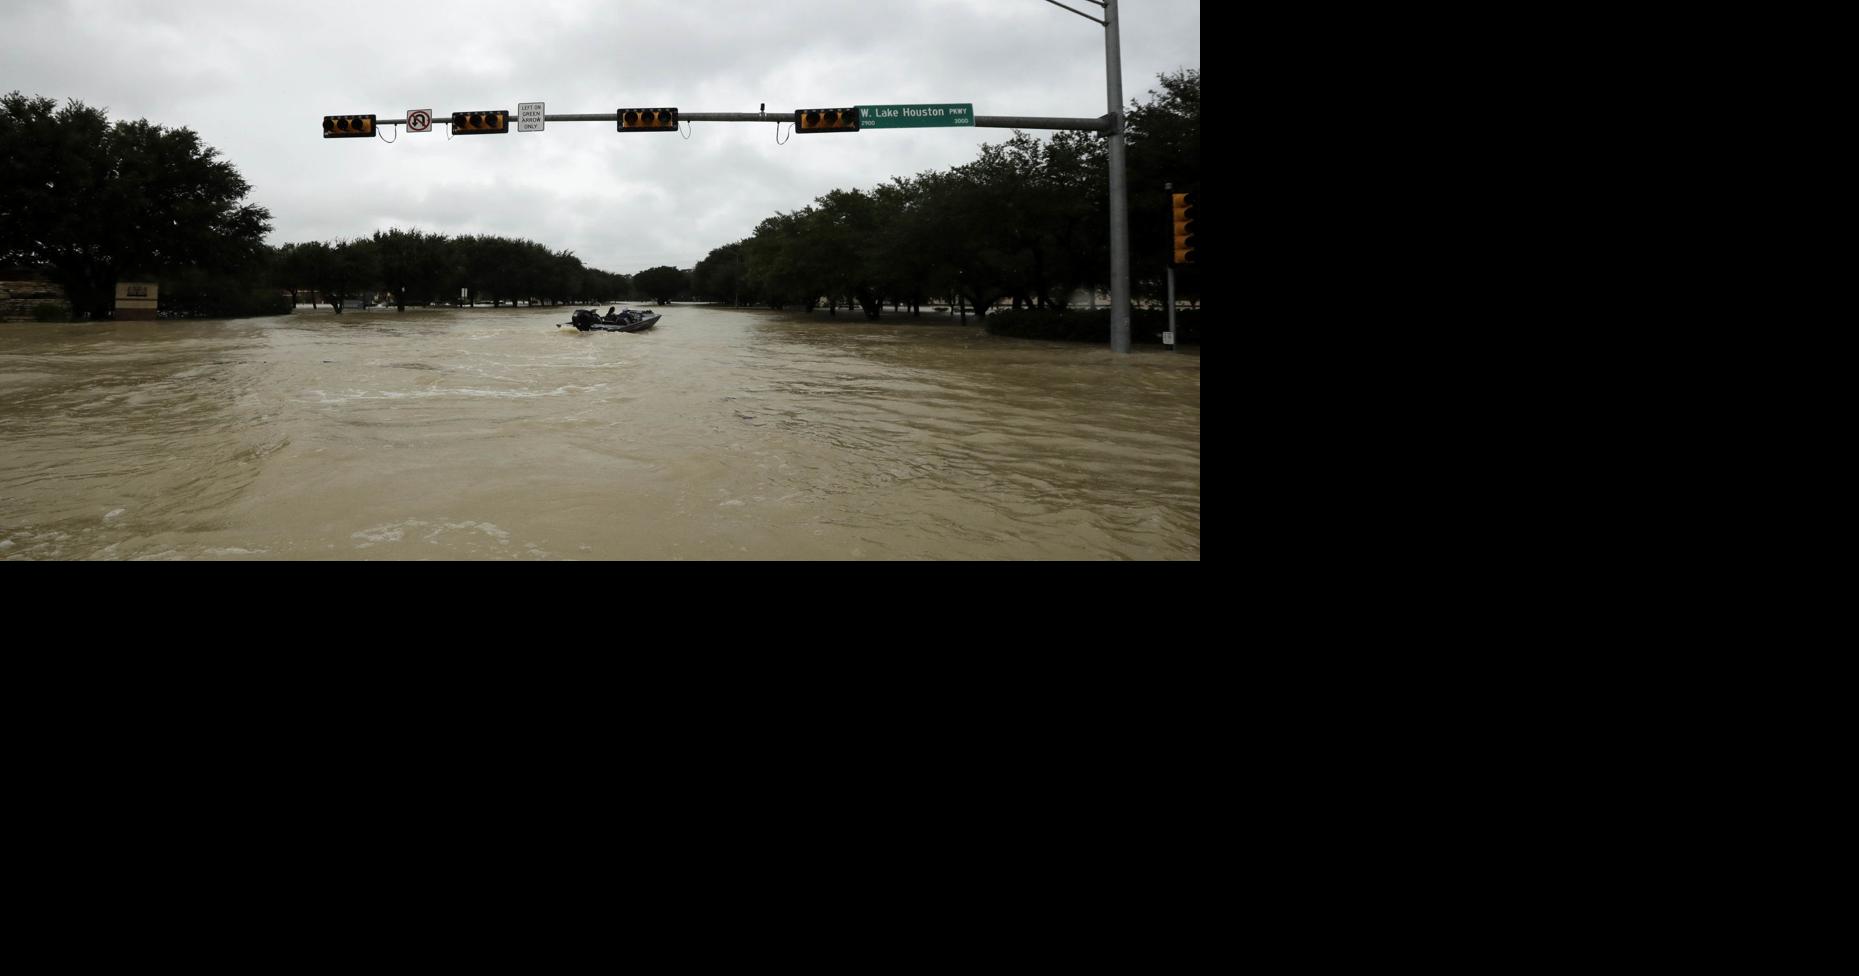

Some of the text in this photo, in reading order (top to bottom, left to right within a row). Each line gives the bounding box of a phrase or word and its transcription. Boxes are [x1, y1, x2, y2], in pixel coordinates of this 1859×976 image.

[860, 108, 872, 118] W.
[875, 107, 899, 117] Lake
[902, 107, 945, 117] Houston
